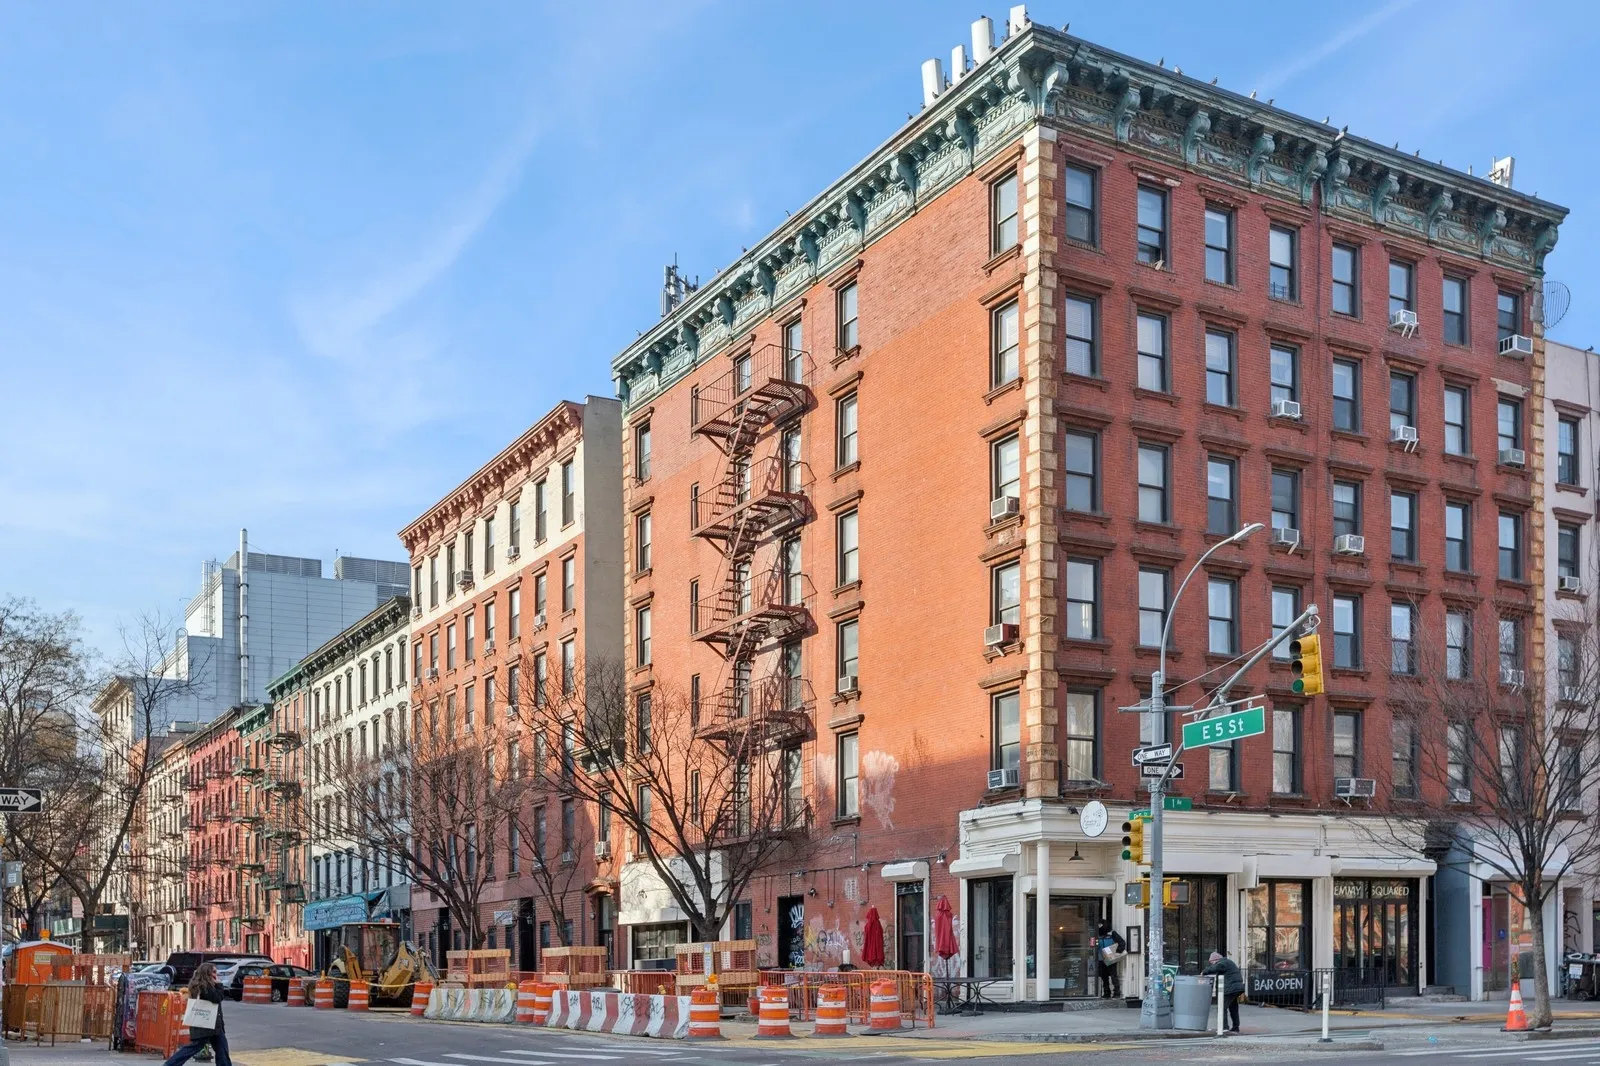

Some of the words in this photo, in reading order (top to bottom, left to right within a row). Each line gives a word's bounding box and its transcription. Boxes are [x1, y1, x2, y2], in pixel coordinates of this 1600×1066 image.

[1202, 724, 1211, 740] E
[1215, 721, 1224, 737] 5
[1228, 717, 1244, 734] St
[1137, 752, 1148, 761] ONE
[1154, 749, 1166, 758] WAY
[1146, 766, 1159, 774] ONE
[1, 795, 29, 806] WAY
[1171, 798, 1175, 809] 1
[1333, 885, 1362, 896] EMMY
[1371, 885, 1410, 897] SQUARED
[1254, 979, 1274, 991] BAR
[1275, 977, 1303, 990] OPEN
